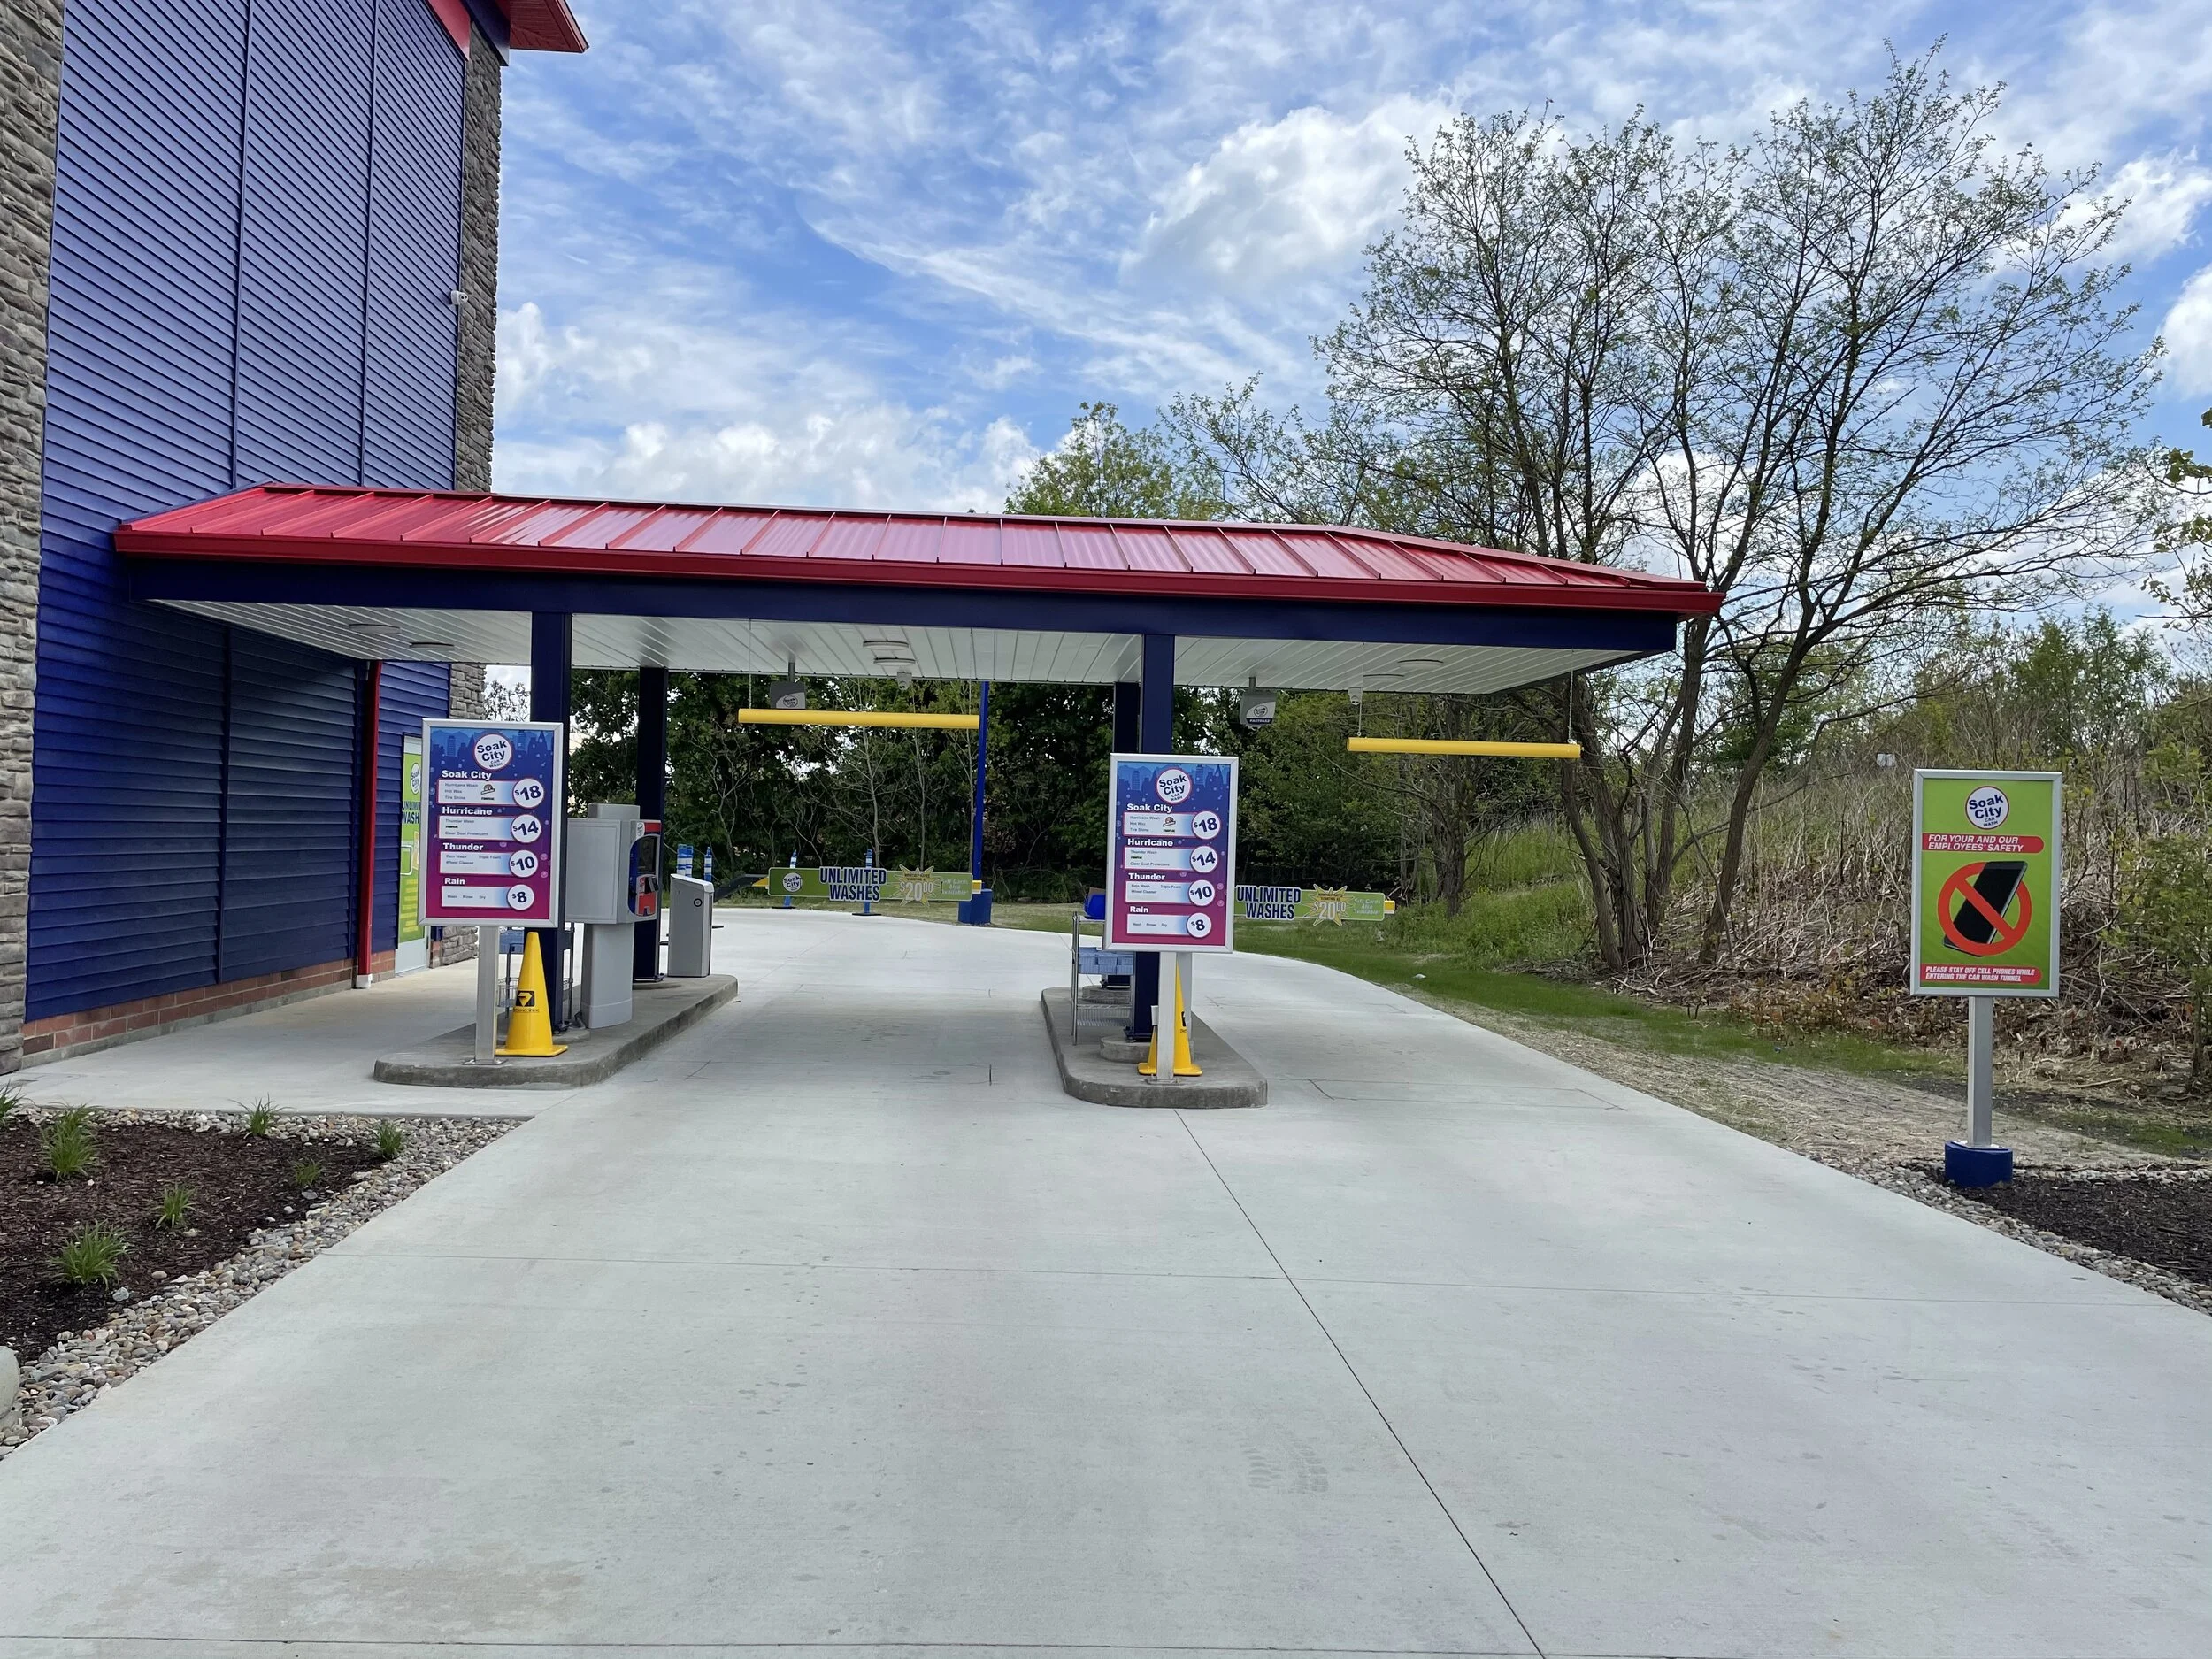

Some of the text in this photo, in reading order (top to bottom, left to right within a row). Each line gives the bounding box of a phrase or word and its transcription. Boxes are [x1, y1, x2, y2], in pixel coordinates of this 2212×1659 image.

[477, 740, 507, 754] Soak
[482, 750, 504, 761] City
[442, 770, 492, 780] Soak City
[1159, 775, 1187, 787] Soak
[515, 785, 541, 800] $18
[1164, 785, 1185, 795] City
[1154, 804, 1172, 813] City
[1969, 795, 2003, 810] Soak
[403, 812, 419, 824] WASH
[1974, 806, 2002, 819] City
[513, 821, 538, 835] $14
[1194, 818, 1217, 832] $18
[442, 842, 483, 851] Thunder
[1928, 842, 1986, 851] EMPLOYEES'
[511, 856, 535, 871] $10
[1192, 851, 1216, 866] $14
[820, 868, 887, 885] UNLIMITED
[511, 891, 527, 903] $8
[830, 885, 879, 901] WASHES
[1190, 886, 1212, 900] $10
[1237, 887, 1301, 902] UNLIMITED
[1247, 903, 1294, 918] WASHES
[1191, 919, 1205, 931] $8
